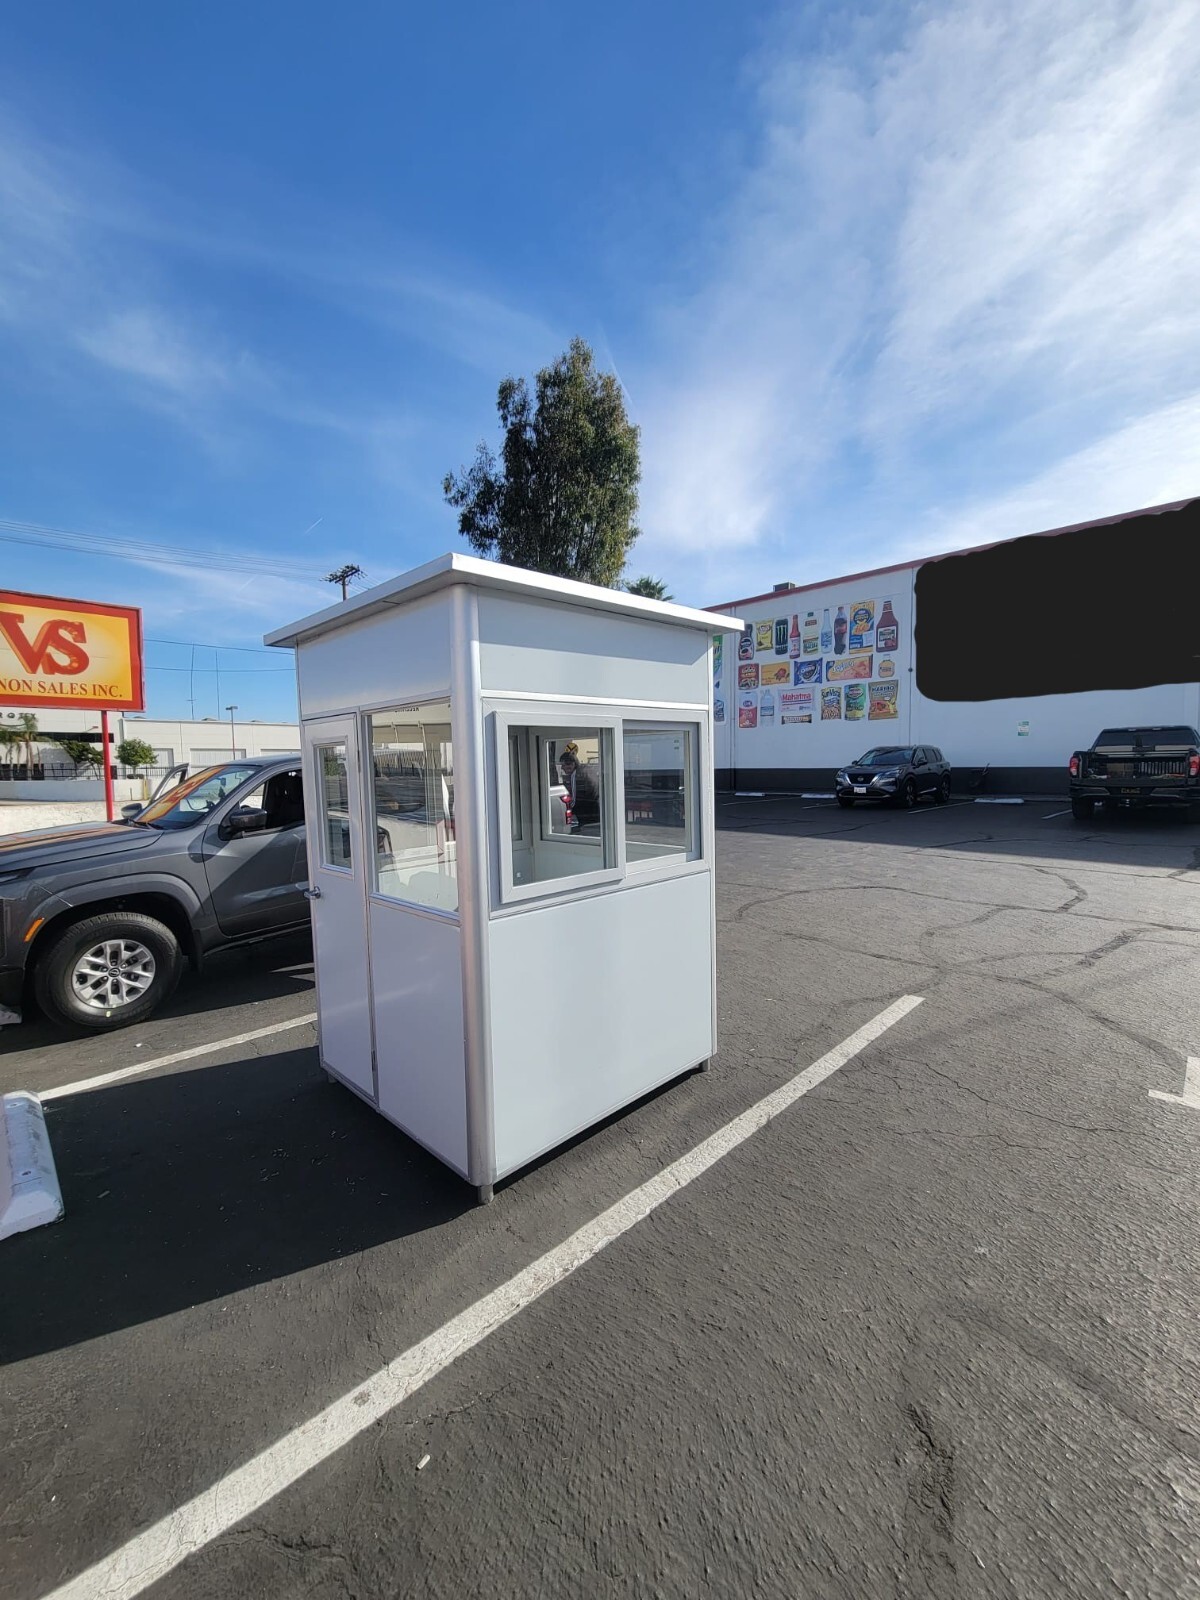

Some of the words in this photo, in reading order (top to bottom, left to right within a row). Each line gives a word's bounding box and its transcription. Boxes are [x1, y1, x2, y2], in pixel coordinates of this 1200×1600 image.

[0, 611, 89, 675] VS
[38, 681, 88, 696] SALES
[92, 684, 123, 698] INC.
[782, 693, 812, 701] Mahatma
